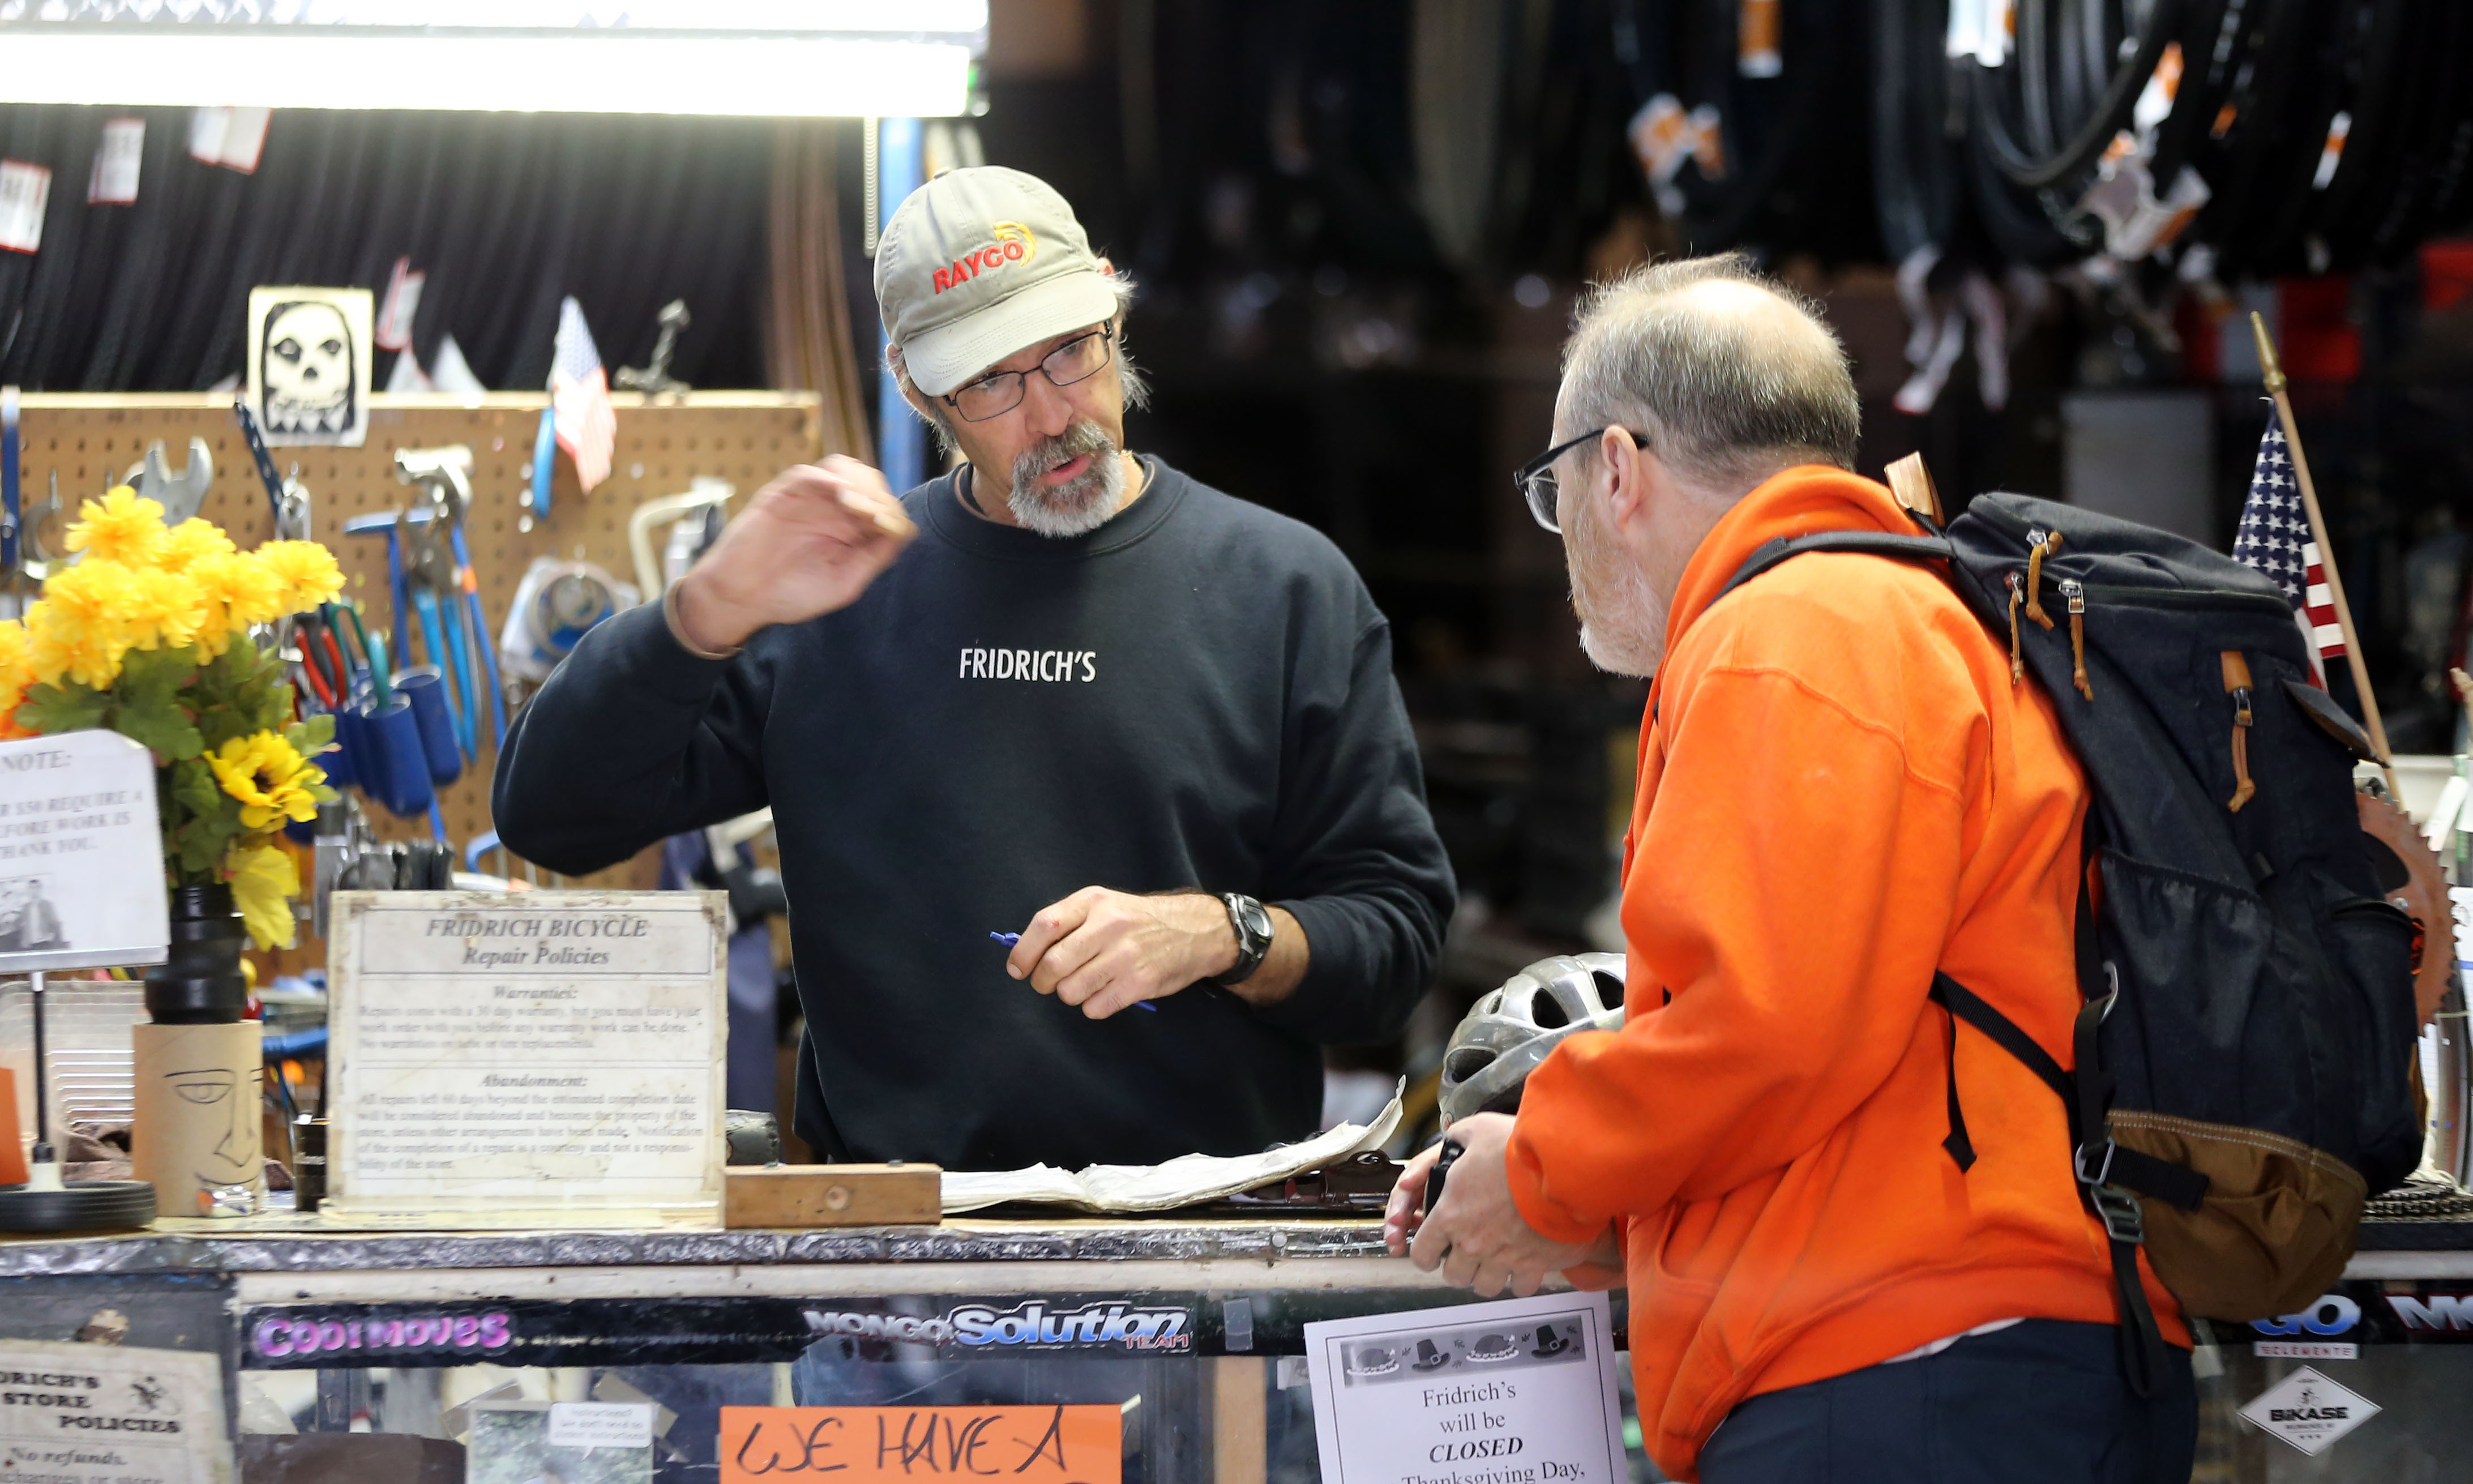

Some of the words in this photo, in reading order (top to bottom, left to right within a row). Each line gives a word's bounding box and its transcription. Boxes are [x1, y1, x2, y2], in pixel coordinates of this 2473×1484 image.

[932, 240, 1024, 294] RAYCO
[959, 648, 1097, 683] FRIDRICH'S
[426, 918, 542, 938] FRIDRICH
[548, 918, 648, 938] BICYCLE
[462, 947, 529, 969] Repair
[533, 946, 610, 965] Policies
[480, 1074, 588, 1087] Abandonment:
[953, 1305, 1188, 1345] Solution
[1122, 1334, 1190, 1349] TEAM
[4, 1392, 92, 1409] STORE
[1423, 1382, 1517, 1408] Fridrich's
[59, 1415, 181, 1433] POLICIES
[1439, 1412, 1477, 1434] will
[1483, 1411, 1507, 1429] be
[737, 1417, 849, 1474] WE
[876, 1412, 1004, 1474] HAVE
[1012, 1405, 1067, 1474] A
[1428, 1436, 1524, 1464] CLOSED
[1542, 1460, 1586, 1482] Day,
